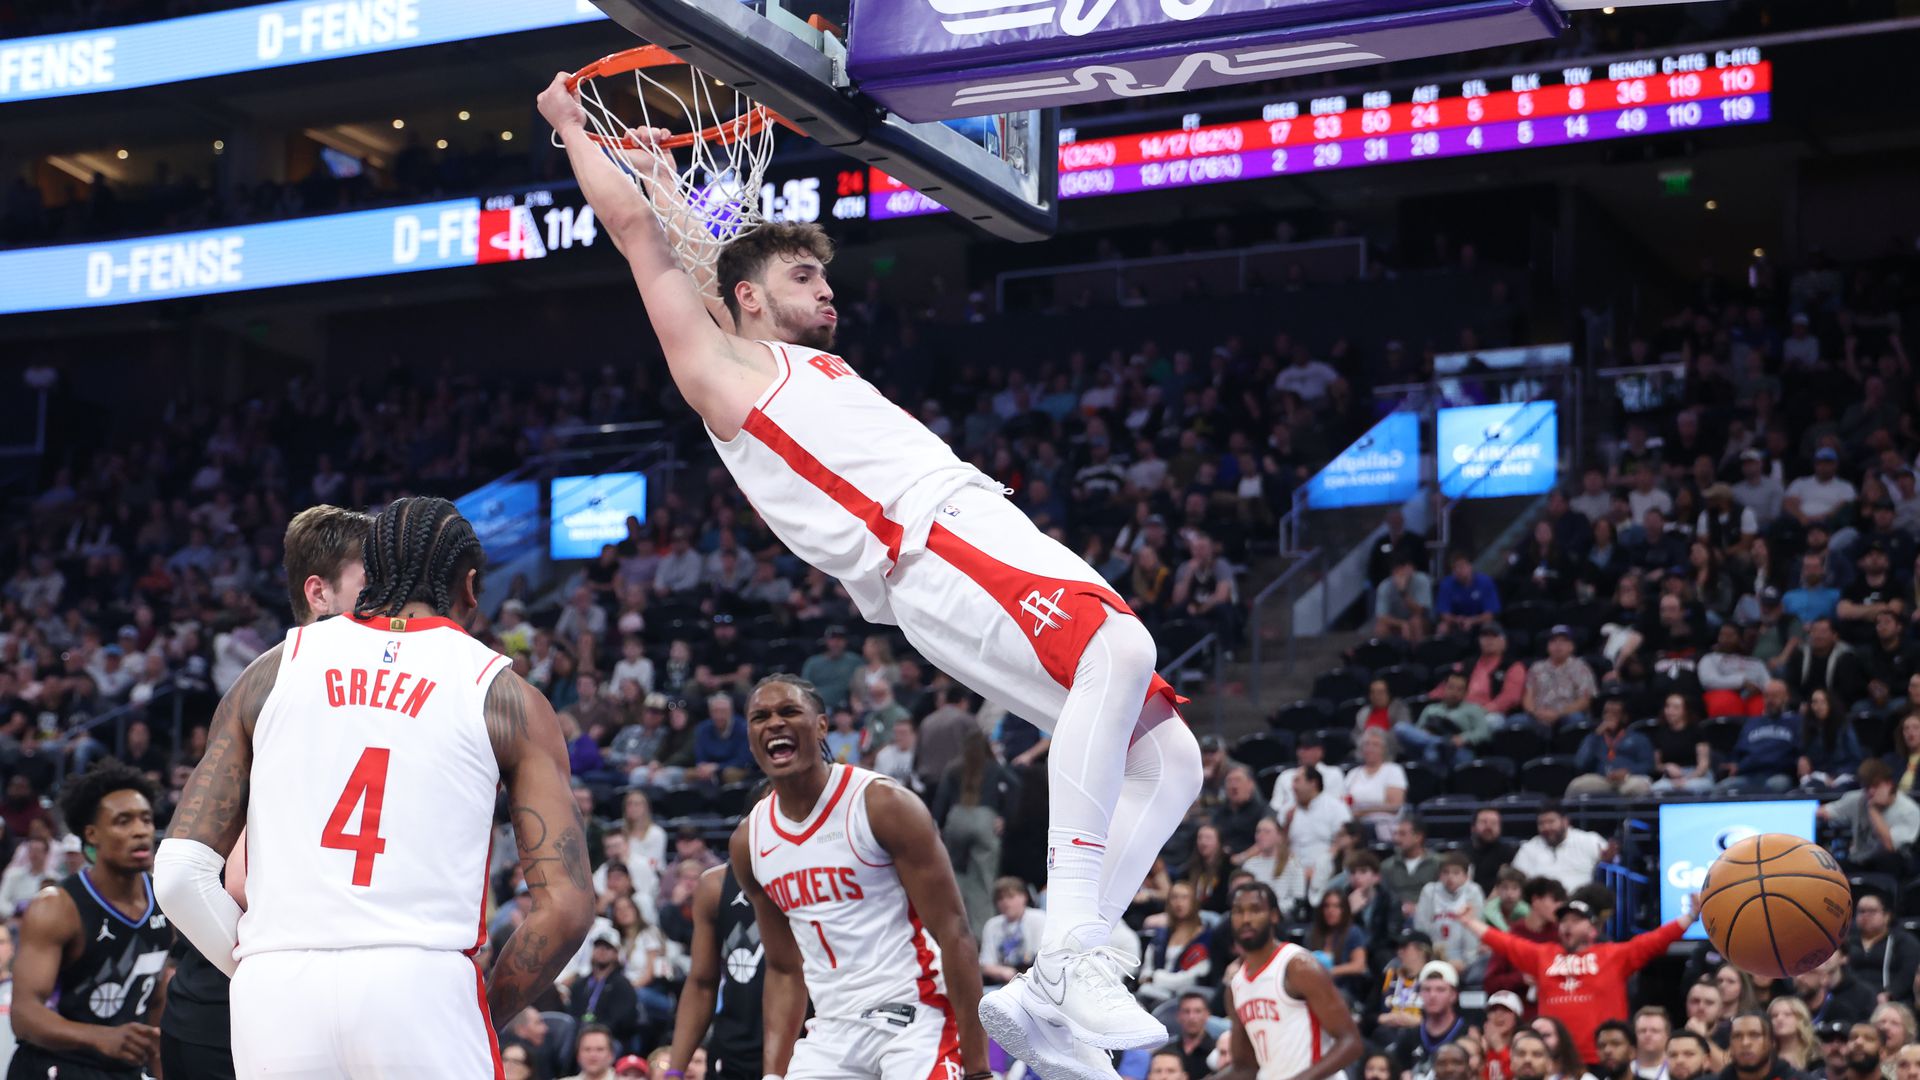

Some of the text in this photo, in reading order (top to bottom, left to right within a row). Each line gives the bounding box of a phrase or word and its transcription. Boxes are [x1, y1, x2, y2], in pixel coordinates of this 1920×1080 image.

[256, 0, 419, 60] D-FENSE
[1268, 121, 1292, 145] 17
[1313, 115, 1342, 140] 33
[1361, 109, 1392, 134] 50
[1410, 104, 1440, 128] 24
[1467, 98, 1484, 122] 5
[1517, 92, 1534, 116] 5
[1568, 86, 1585, 110] 8
[1616, 80, 1647, 104] 36
[1719, 67, 1755, 92] 110
[1271, 148, 1288, 172] 2
[1363, 137, 1388, 161] 31
[1465, 126, 1483, 149] 4
[1563, 114, 1589, 138] 14
[1666, 101, 1702, 127] 110
[760, 177, 821, 223] 1:35
[832, 195, 866, 220] 4TH
[836, 171, 864, 196] 24
[543, 204, 597, 250] 114
[86, 236, 243, 298] D-FENSE
[325, 668, 437, 719] GREEN
[320, 746, 390, 887] 4
[764, 867, 865, 913] ROCKETS
[809, 920, 837, 969] 1
[135, 975, 156, 1016] 2
